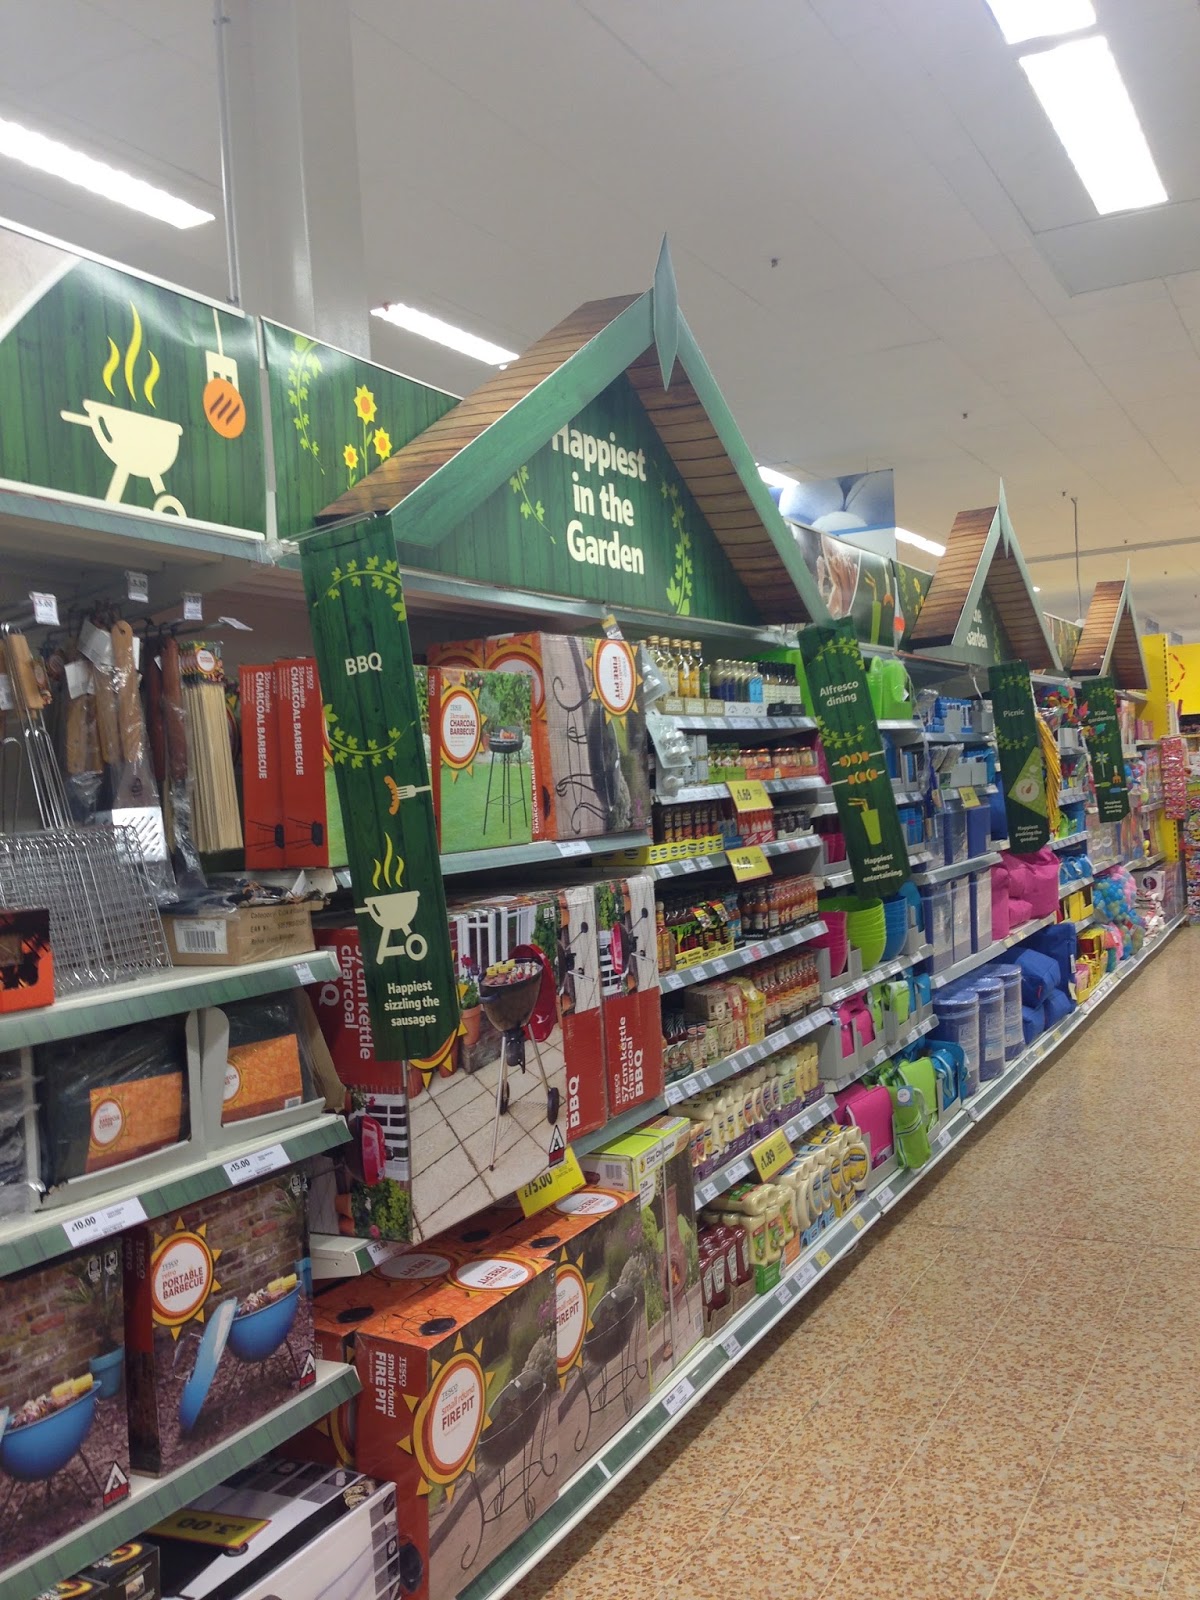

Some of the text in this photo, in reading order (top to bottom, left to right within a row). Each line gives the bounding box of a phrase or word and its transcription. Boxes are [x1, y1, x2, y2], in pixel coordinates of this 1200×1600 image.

[552, 423, 647, 482] Happiest
[571, 471, 635, 527] in the
[566, 519, 645, 575] Garden
[345, 652, 383, 676] BBQ
[820, 681, 859, 697] Alfresco
[826, 693, 857, 707] dining
[255, 671, 267, 779] CHARCOAL BARBECUE
[291, 666, 304, 776] CHARCOAL BARBECUE
[449, 720, 476, 728] CHARCOAL
[1003, 709, 1025, 718] Picnic
[449, 728, 475, 736] BARBECUE
[864, 854, 893, 865] Happiest
[863, 870, 903, 882] entertaining
[341, 945, 359, 1029] charcoal
[387, 980, 432, 995] Happiest
[384, 996, 440, 1011] sizzling the
[358, 1002, 374, 1060] kettle
[391, 1014, 437, 1027] sausages
[619, 1016, 629, 1104] 57cm kettle
[626, 1036, 635, 1100] charcoal
[634, 1048, 644, 1097] BBQ
[568, 1074, 580, 1128] BBQ
[230, 1159, 250, 1172] £15.00
[761, 1149, 776, 1170] £1.89
[524, 1172, 553, 1198] £75.00
[71, 1216, 96, 1232] £10.00
[162, 1260, 179, 1272] TESCO
[162, 1270, 177, 1280] retro
[477, 1265, 507, 1285] FIRE PIT
[162, 1267, 203, 1290] PORTABLE
[163, 1276, 204, 1300] BARBECUE
[570, 1301, 580, 1317] PIT
[375, 1351, 387, 1415] FIRE PIT
[399, 1356, 407, 1387] TESCO
[387, 1353, 396, 1418] small round
[442, 1383, 459, 1401] TESCO
[441, 1382, 476, 1416] small round
[442, 1395, 475, 1431] FIRE PIT
